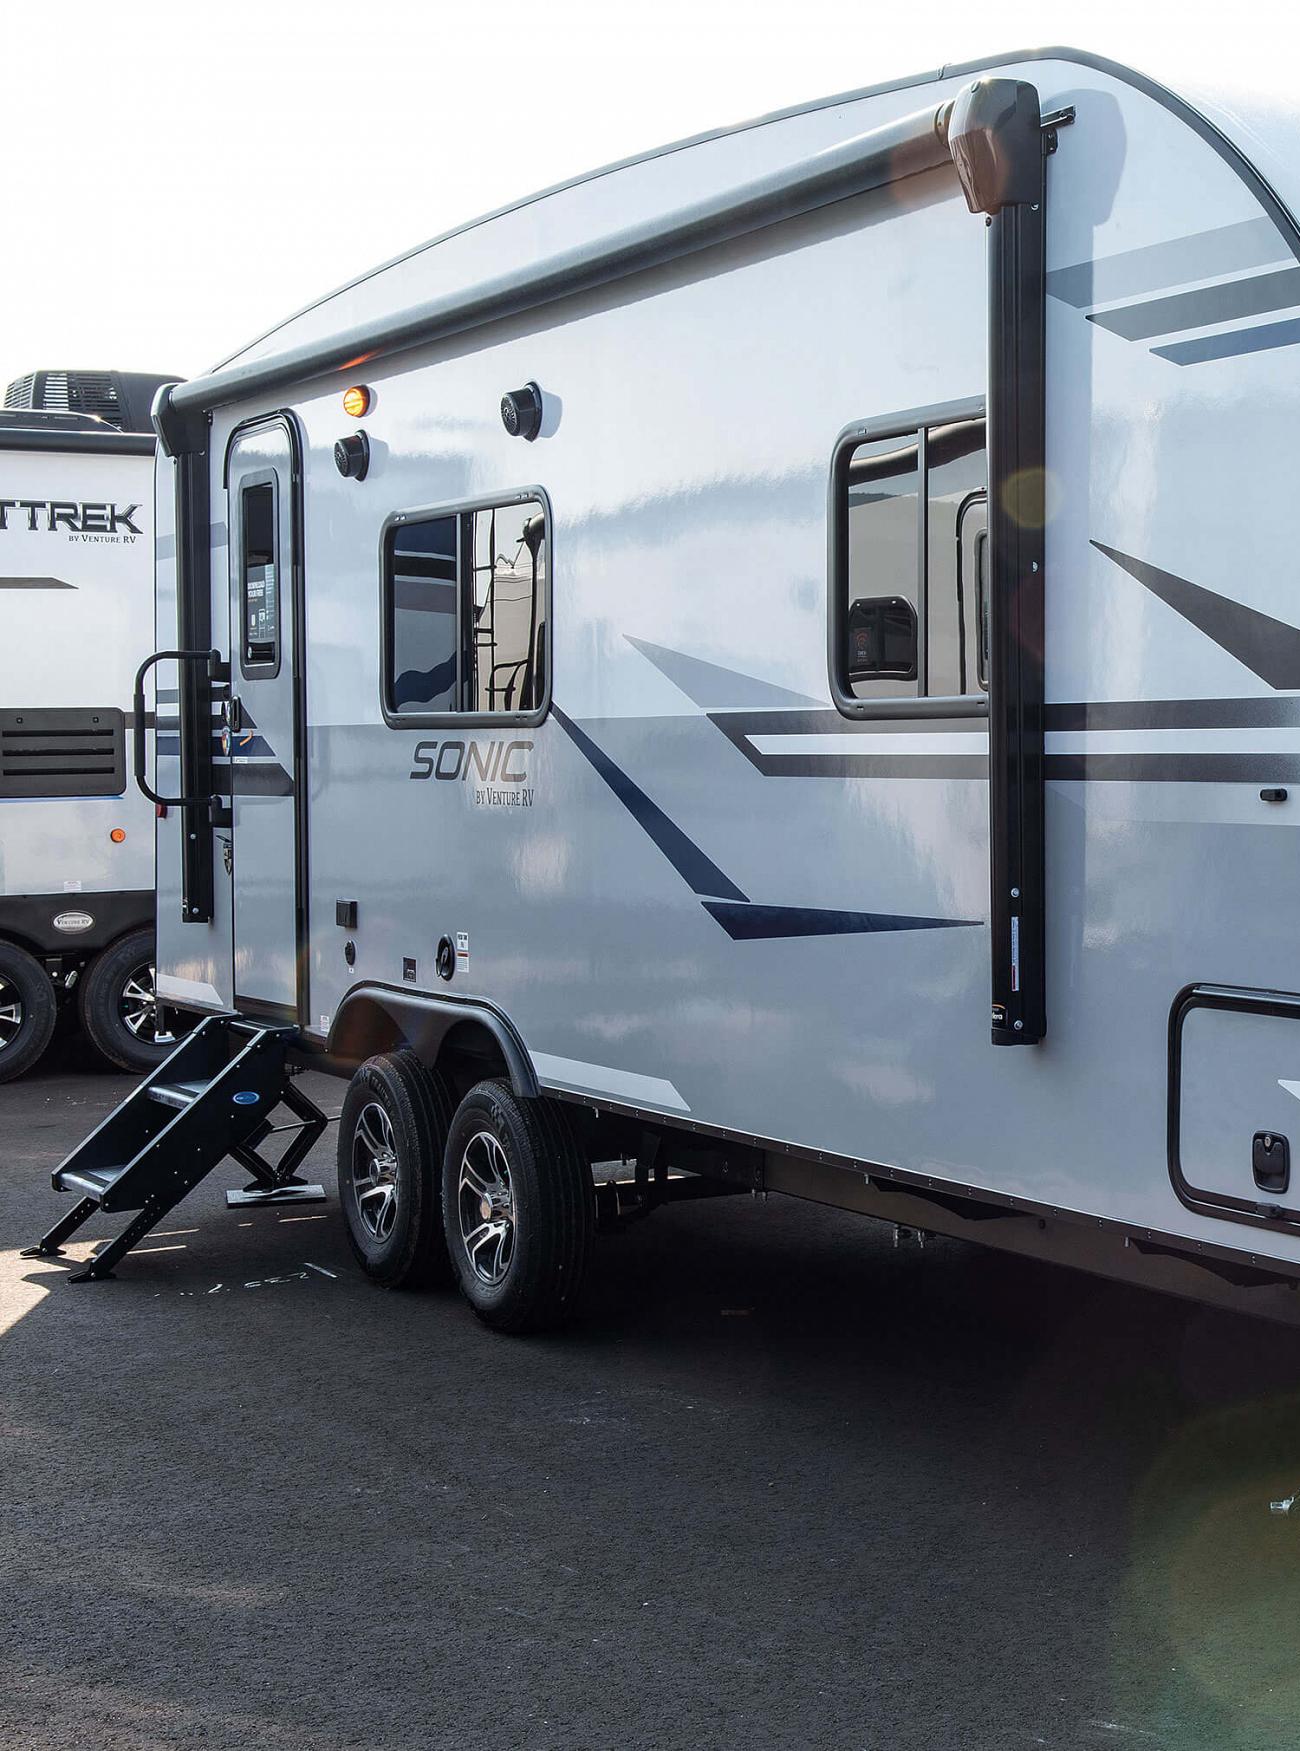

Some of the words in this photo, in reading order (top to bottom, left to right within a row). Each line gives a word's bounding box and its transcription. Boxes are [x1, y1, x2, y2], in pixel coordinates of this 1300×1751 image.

[410, 741, 534, 782] SONIC
[476, 790, 485, 804] BY
[486, 787, 520, 805] VENTURE
[522, 789, 534, 806] RV
